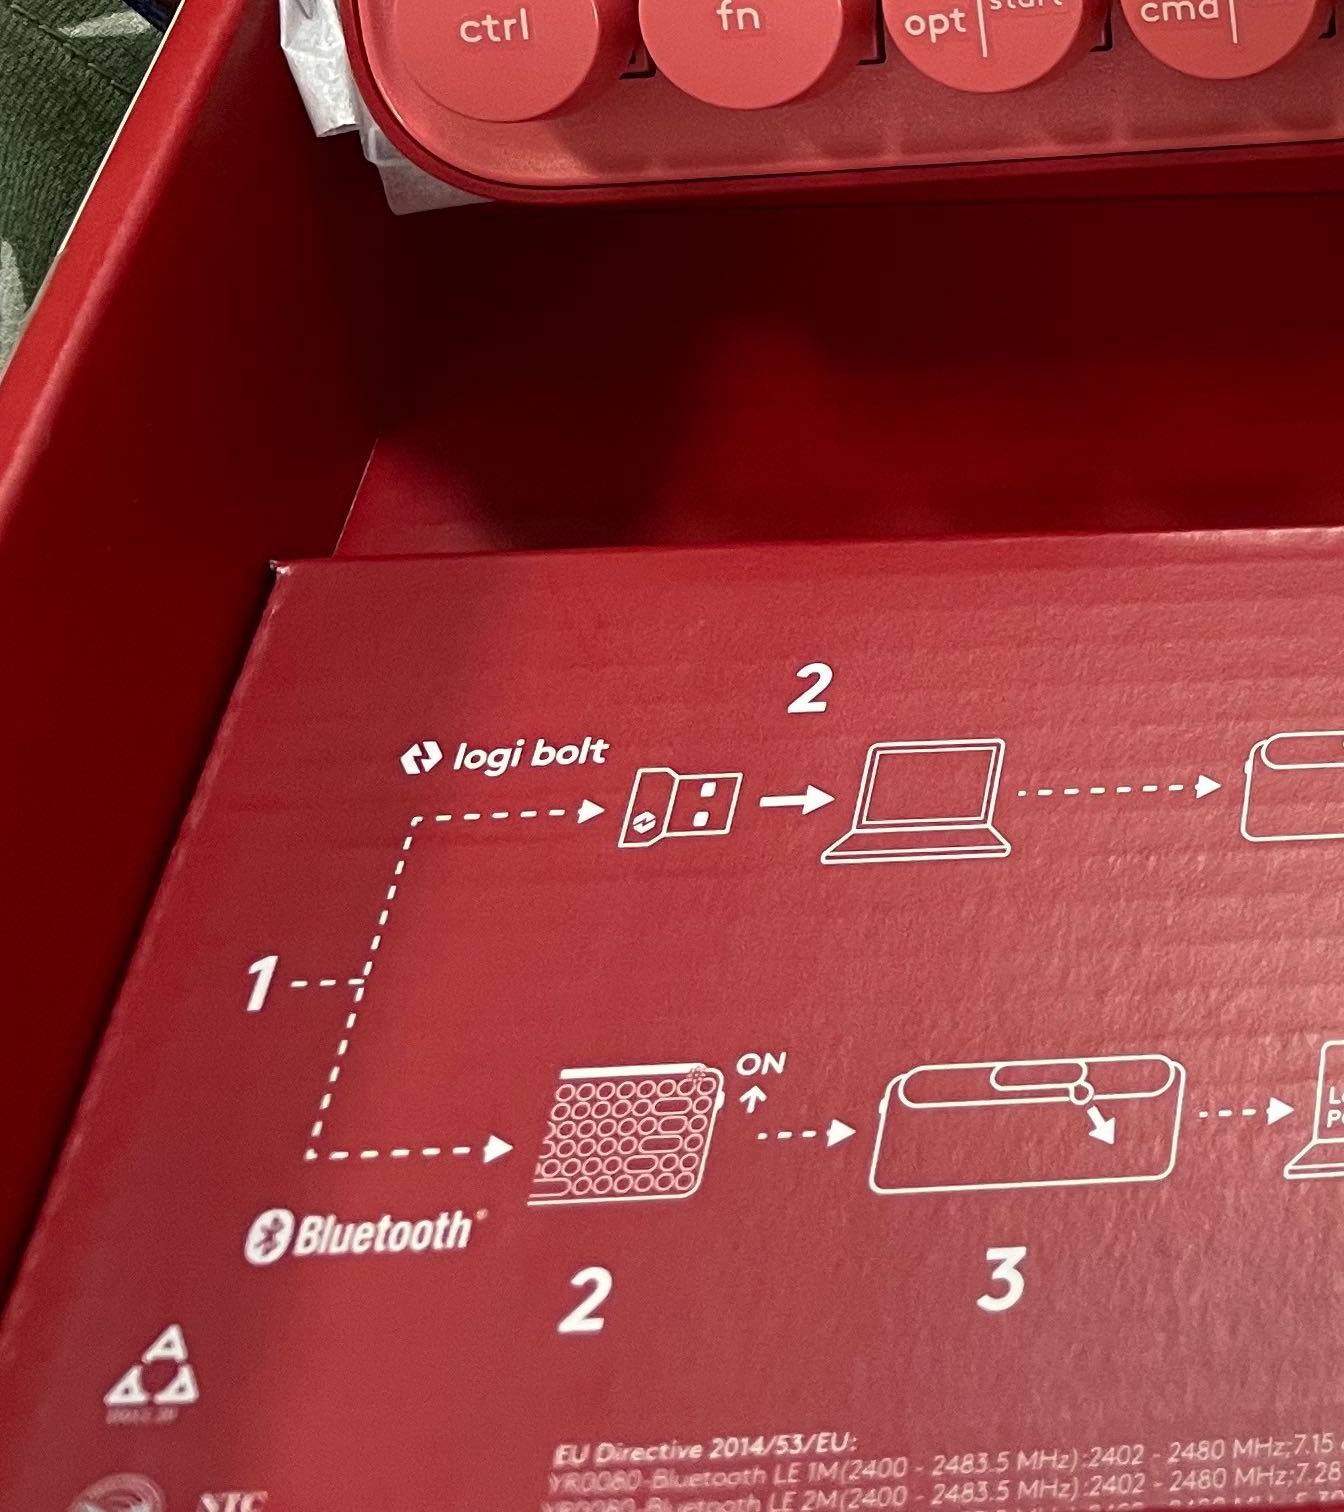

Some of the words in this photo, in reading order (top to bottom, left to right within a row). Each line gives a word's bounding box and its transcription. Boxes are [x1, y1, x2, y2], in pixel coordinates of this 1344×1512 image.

[459, 7, 529, 43] ctrl
[904, 7, 967, 44] opt
[787, 662, 833, 714] 2
[453, 738, 525, 777] logi
[530, 736, 610, 767] bolt
[246, 955, 279, 1012] 1
[736, 1051, 787, 1076] ON
[976, 1246, 1027, 1312] 3
[557, 1266, 613, 1334] 2
[553, 1443, 590, 1466] EU
[594, 1441, 703, 1465] Directive
[773, 1462, 800, 1485] LE
